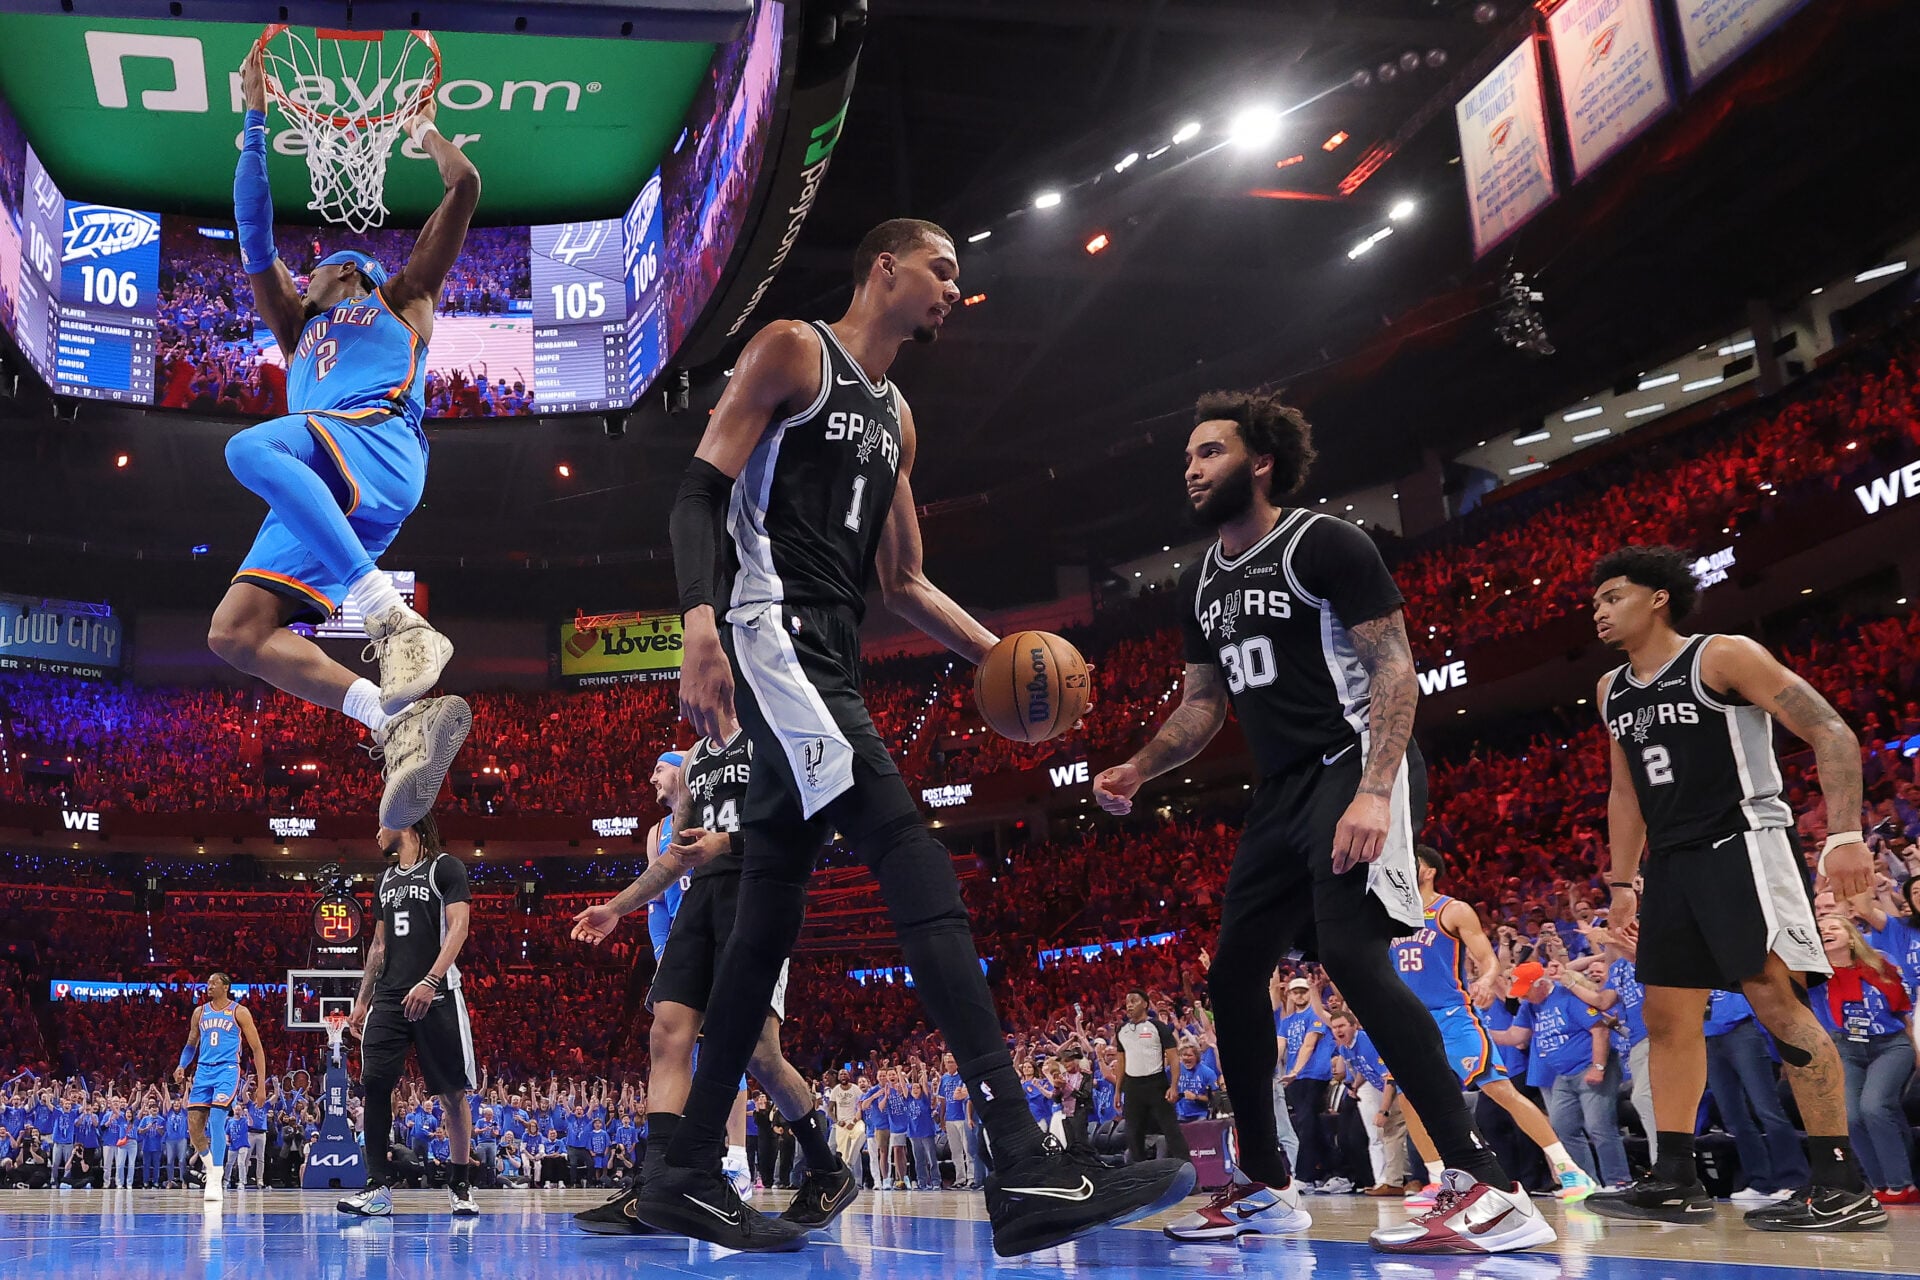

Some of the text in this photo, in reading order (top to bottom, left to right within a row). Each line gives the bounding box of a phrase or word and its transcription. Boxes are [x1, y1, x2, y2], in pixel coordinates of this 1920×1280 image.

[770, 157, 830, 271] paycom
[29, 221, 53, 283] 105
[633, 240, 658, 302] 106
[82, 265, 138, 308] 106
[551, 281, 606, 320] 105
[62, 307, 154, 327] PLAYER PTS FL
[60, 320, 152, 339] GILGEOUS-ALEXANDER 22 3
[535, 329, 558, 337] PLAYER
[602, 325, 615, 333] PTS
[59, 332, 95, 345] HOLMGREN
[146, 344, 151, 352] 2
[534, 340, 578, 349] WEMBANYAMA
[57, 358, 85, 369] CARUSO
[58, 346, 90, 357] WILLIAMS
[146, 356, 151, 364] 2
[317, 339, 338, 382] 2
[535, 354, 560, 362] HARPER
[57, 371, 89, 383] MITCHELL
[145, 382, 150, 390] 4
[535, 367, 558, 375] CASTLE
[61, 385, 71, 394] TO
[82, 388, 91, 396] TF
[112, 391, 122, 400] OT
[540, 405, 549, 413] TO
[561, 404, 569, 412] TF
[589, 401, 599, 409] OT
[1854, 458, 1920, 515] WE
[844, 474, 868, 533] 1
[1708, 545, 1736, 570] OAK
[1248, 566, 1274, 575] LEDGER
[68, 616, 116, 658] CITY
[73, 667, 103, 678] NOW
[1219, 634, 1279, 696] 30
[579, 676, 618, 686] BRING
[1026, 647, 1050, 723] Wilson
[1416, 660, 1468, 696] WE
[1608, 703, 1700, 740] SPURS
[1049, 761, 1090, 787] WE
[1641, 744, 1675, 787] 2
[922, 783, 973, 801] POST OAK
[929, 796, 966, 808] TOYOTA
[62, 810, 100, 831] WE
[269, 818, 316, 830] POST OAK
[592, 817, 639, 830] POST OAK
[702, 799, 741, 833] 24
[275, 829, 310, 837] TOYOTA
[598, 828, 633, 837] TOYOTA
[321, 905, 347, 917] 57.6
[323, 917, 351, 938] 24
[393, 911, 410, 937] 5
[1398, 947, 1423, 972] 25
[200, 1018, 233, 1032] THUNDER
[210, 1031, 218, 1046] 8
[331, 1087, 341, 1096] GET
[331, 1096, 342, 1105] THE
[310, 1154, 358, 1166] KIA
